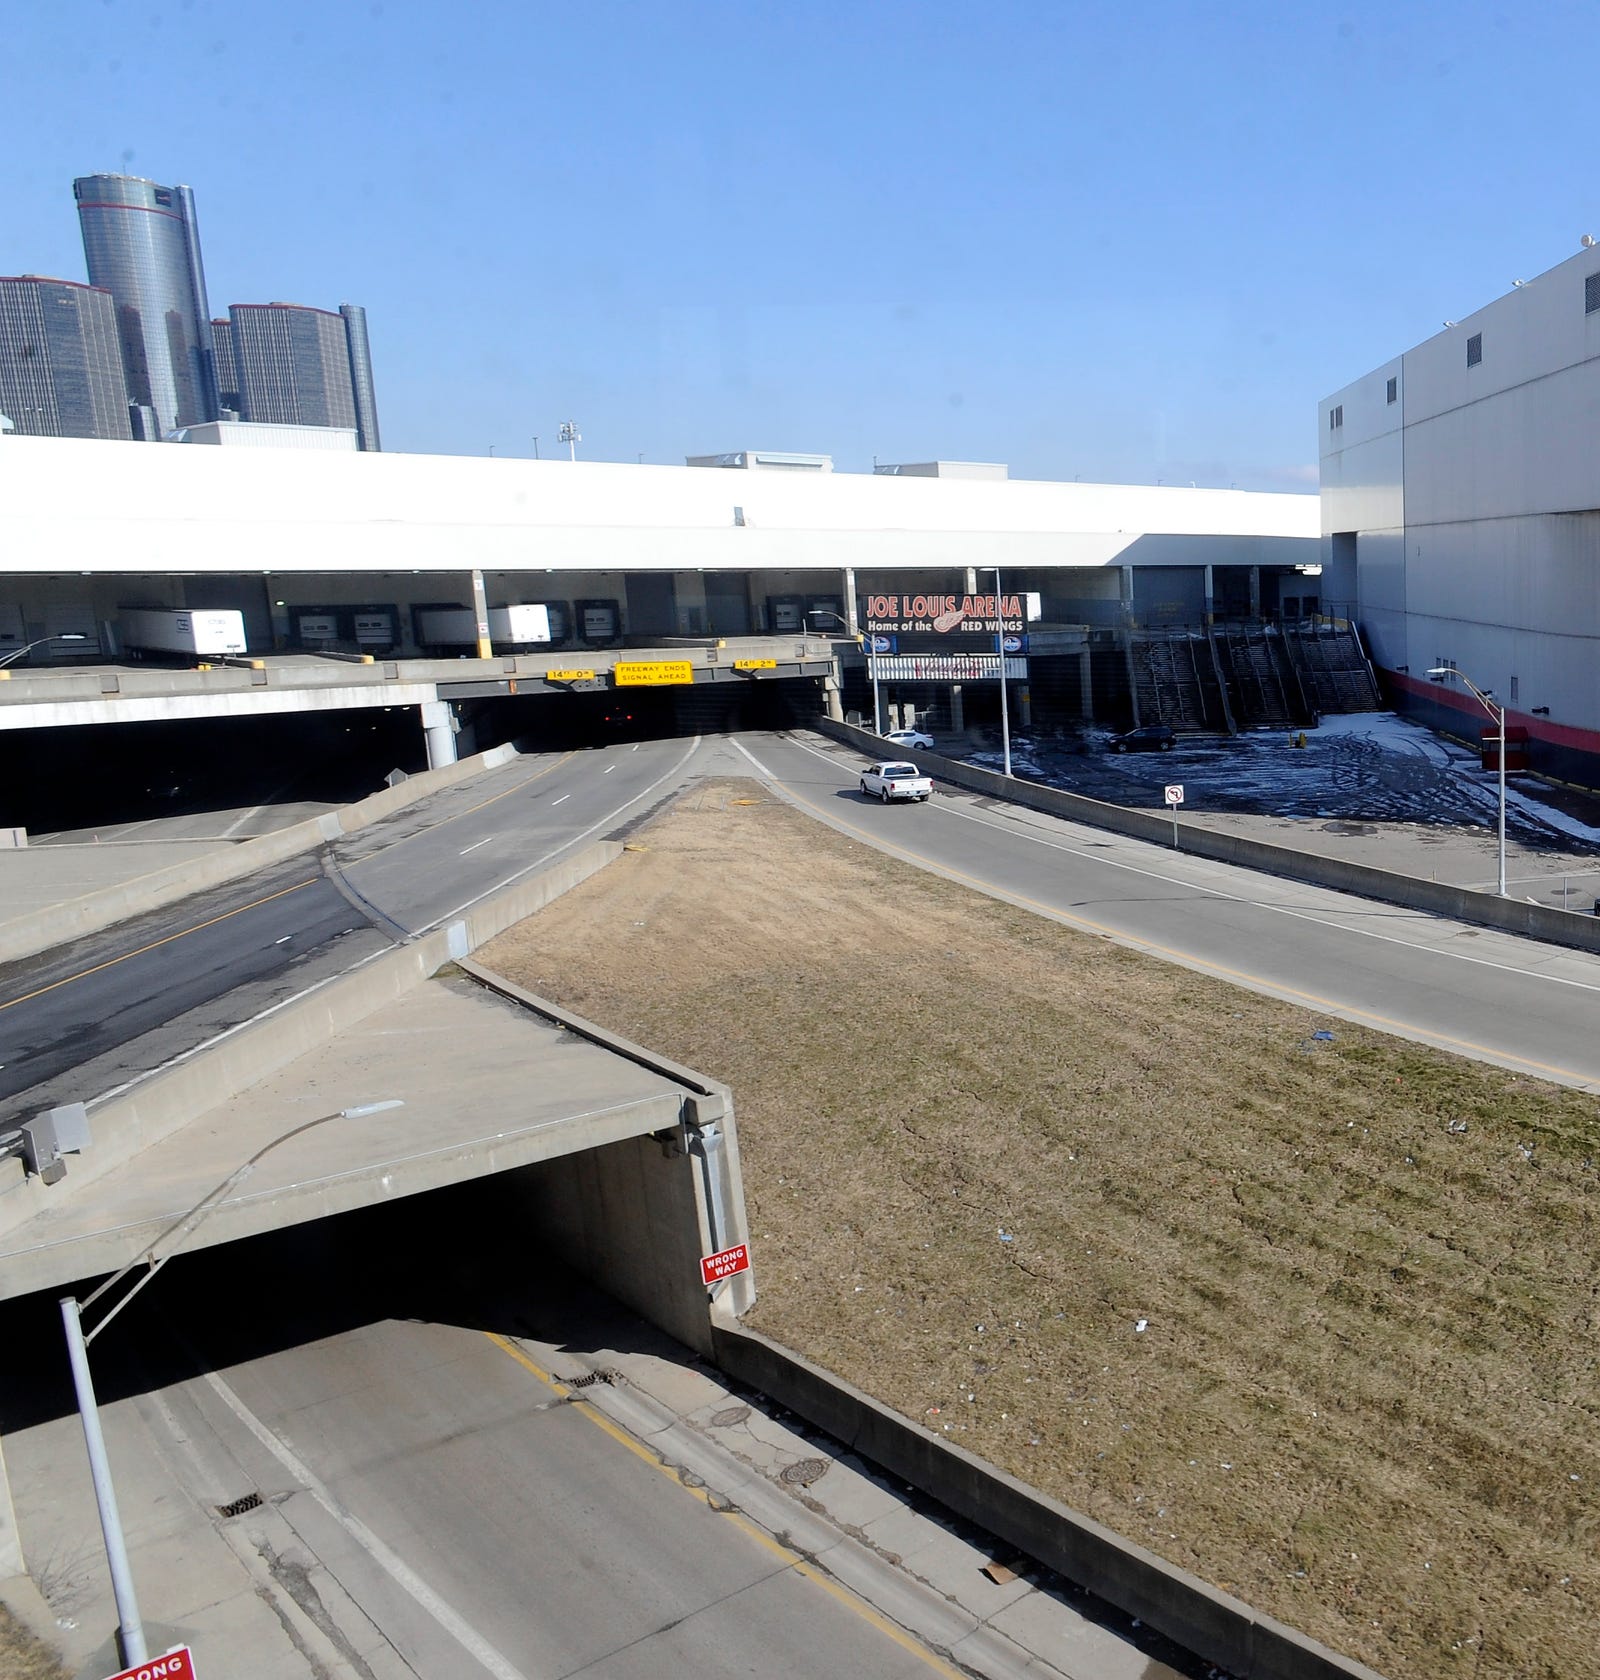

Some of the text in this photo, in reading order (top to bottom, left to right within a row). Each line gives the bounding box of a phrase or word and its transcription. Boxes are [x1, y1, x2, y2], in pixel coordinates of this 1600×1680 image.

[867, 596, 1022, 618] JOE LOUIS ARENA
[868, 620, 1023, 632] Home of the RED WINGS
[705, 1249, 744, 1269] WRONG
[714, 1261, 738, 1276] WAY
